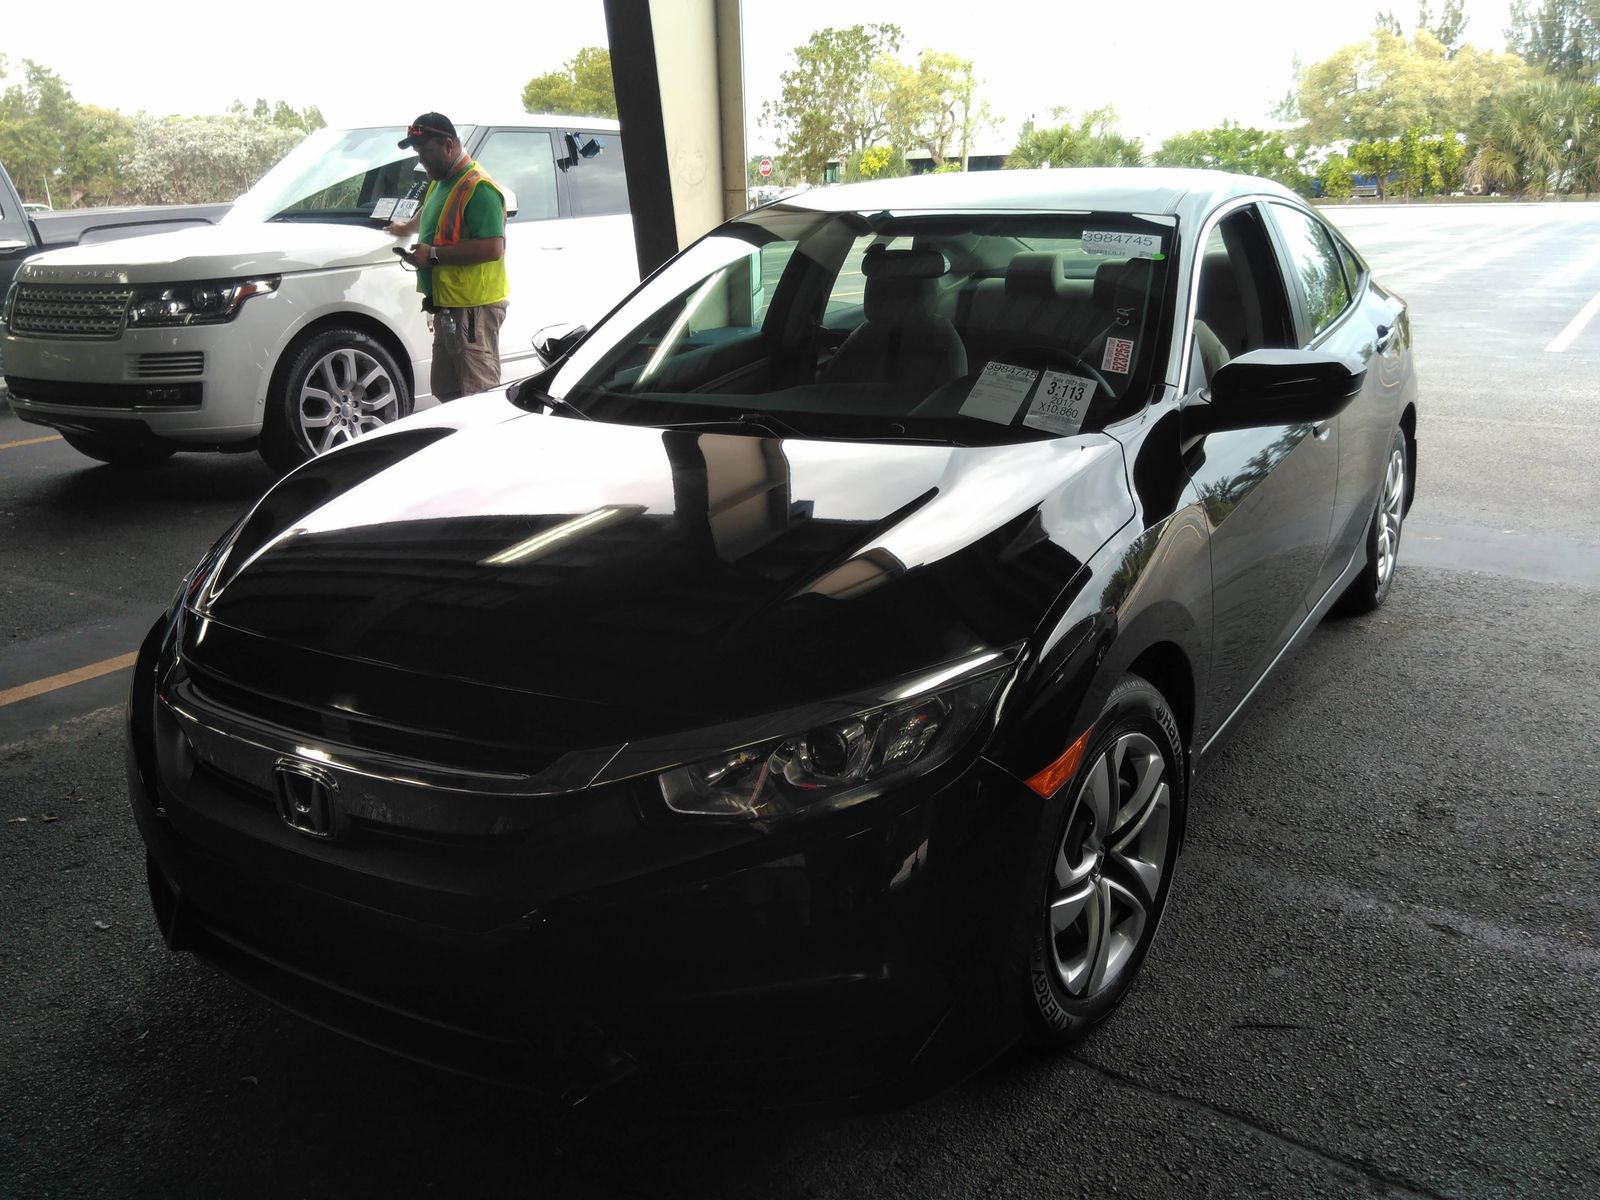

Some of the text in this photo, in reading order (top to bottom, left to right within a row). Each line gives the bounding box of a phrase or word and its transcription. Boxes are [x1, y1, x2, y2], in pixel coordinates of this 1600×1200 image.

[1083, 232, 1153, 247] 3984745
[986, 361, 1038, 379] 3984745
[1047, 381, 1085, 401] 3:113
[1051, 396, 1075, 407] 2017
